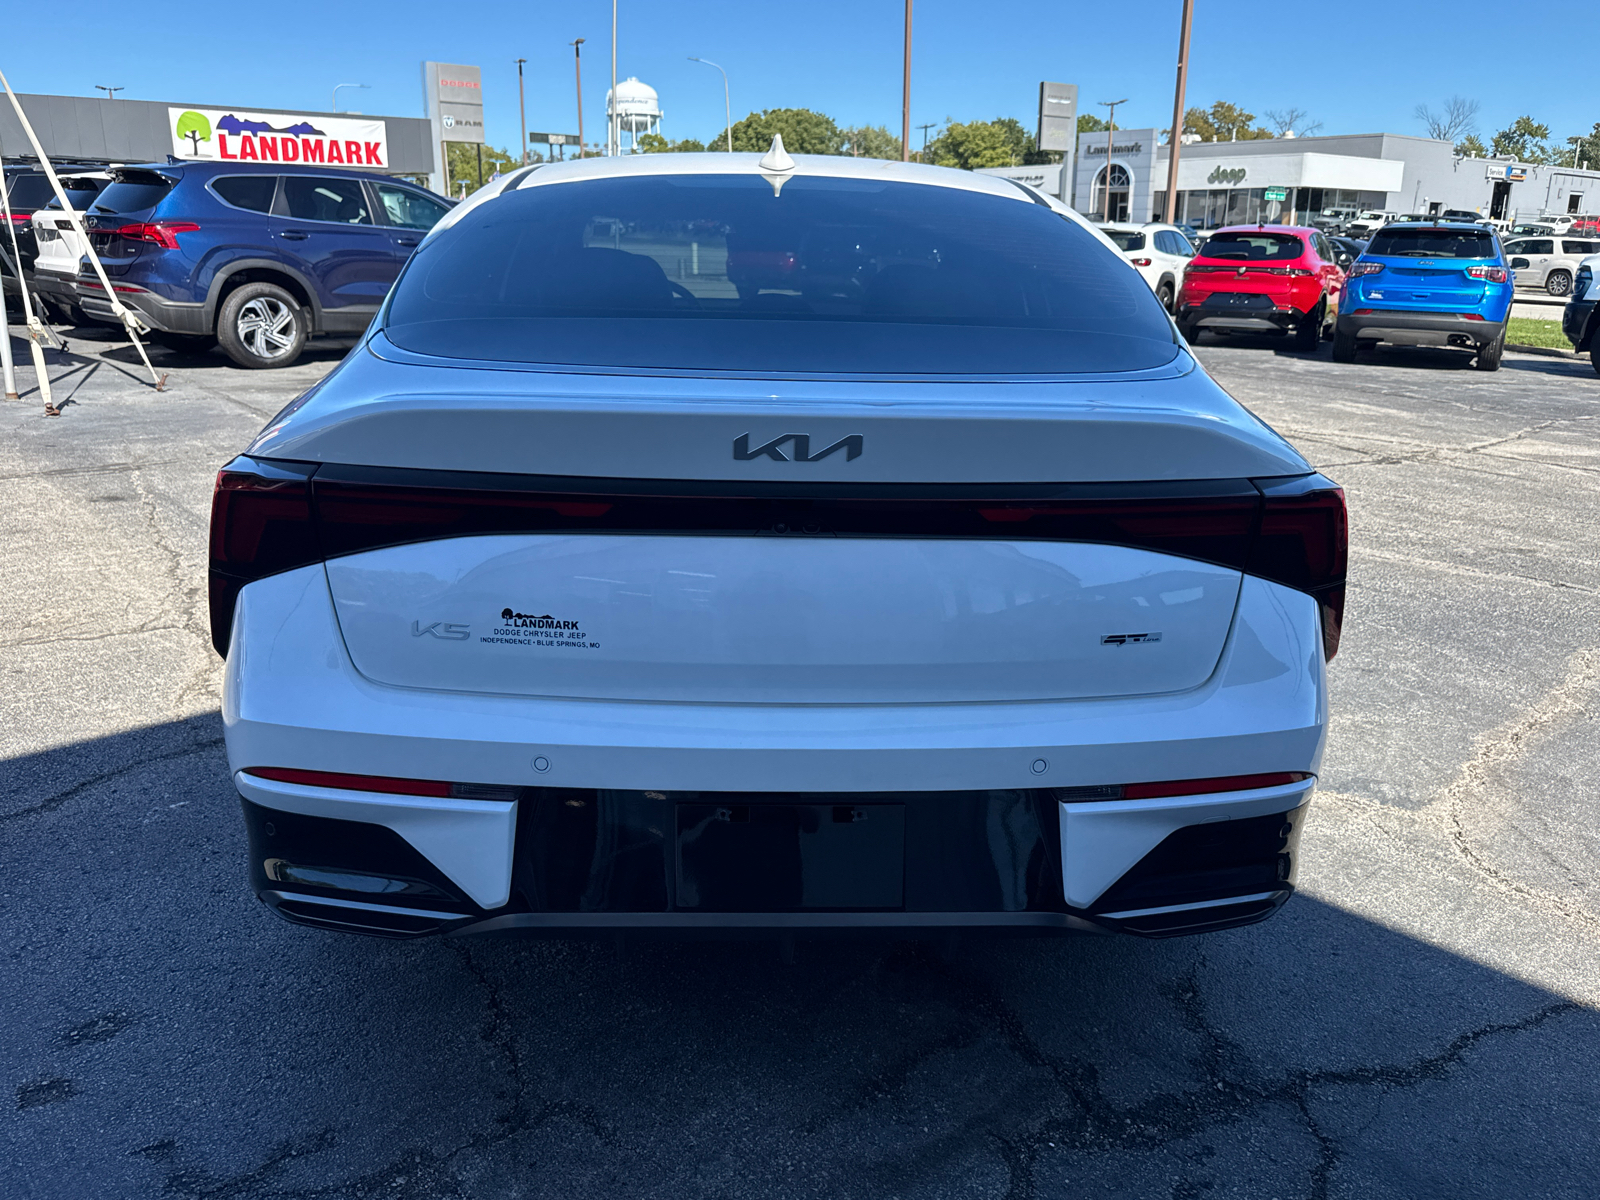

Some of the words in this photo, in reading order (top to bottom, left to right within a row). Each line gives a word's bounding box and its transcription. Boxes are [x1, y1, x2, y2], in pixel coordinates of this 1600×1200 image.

[440, 79, 480, 89] DODGE
[217, 134, 383, 166] LANDMARK
[1086, 142, 1142, 155] Landmark
[1208, 165, 1246, 186] Jeep
[1489, 168, 1504, 176] Service
[733, 432, 863, 462] KIA
[513, 618, 579, 630] LANDMARK
[411, 620, 470, 641] K5
[493, 628, 521, 636] DODGE
[523, 629, 564, 639] CHRYSLER
[480, 637, 532, 646] INDEPENDENCE
[556, 640, 589, 649] SPRINGS,
